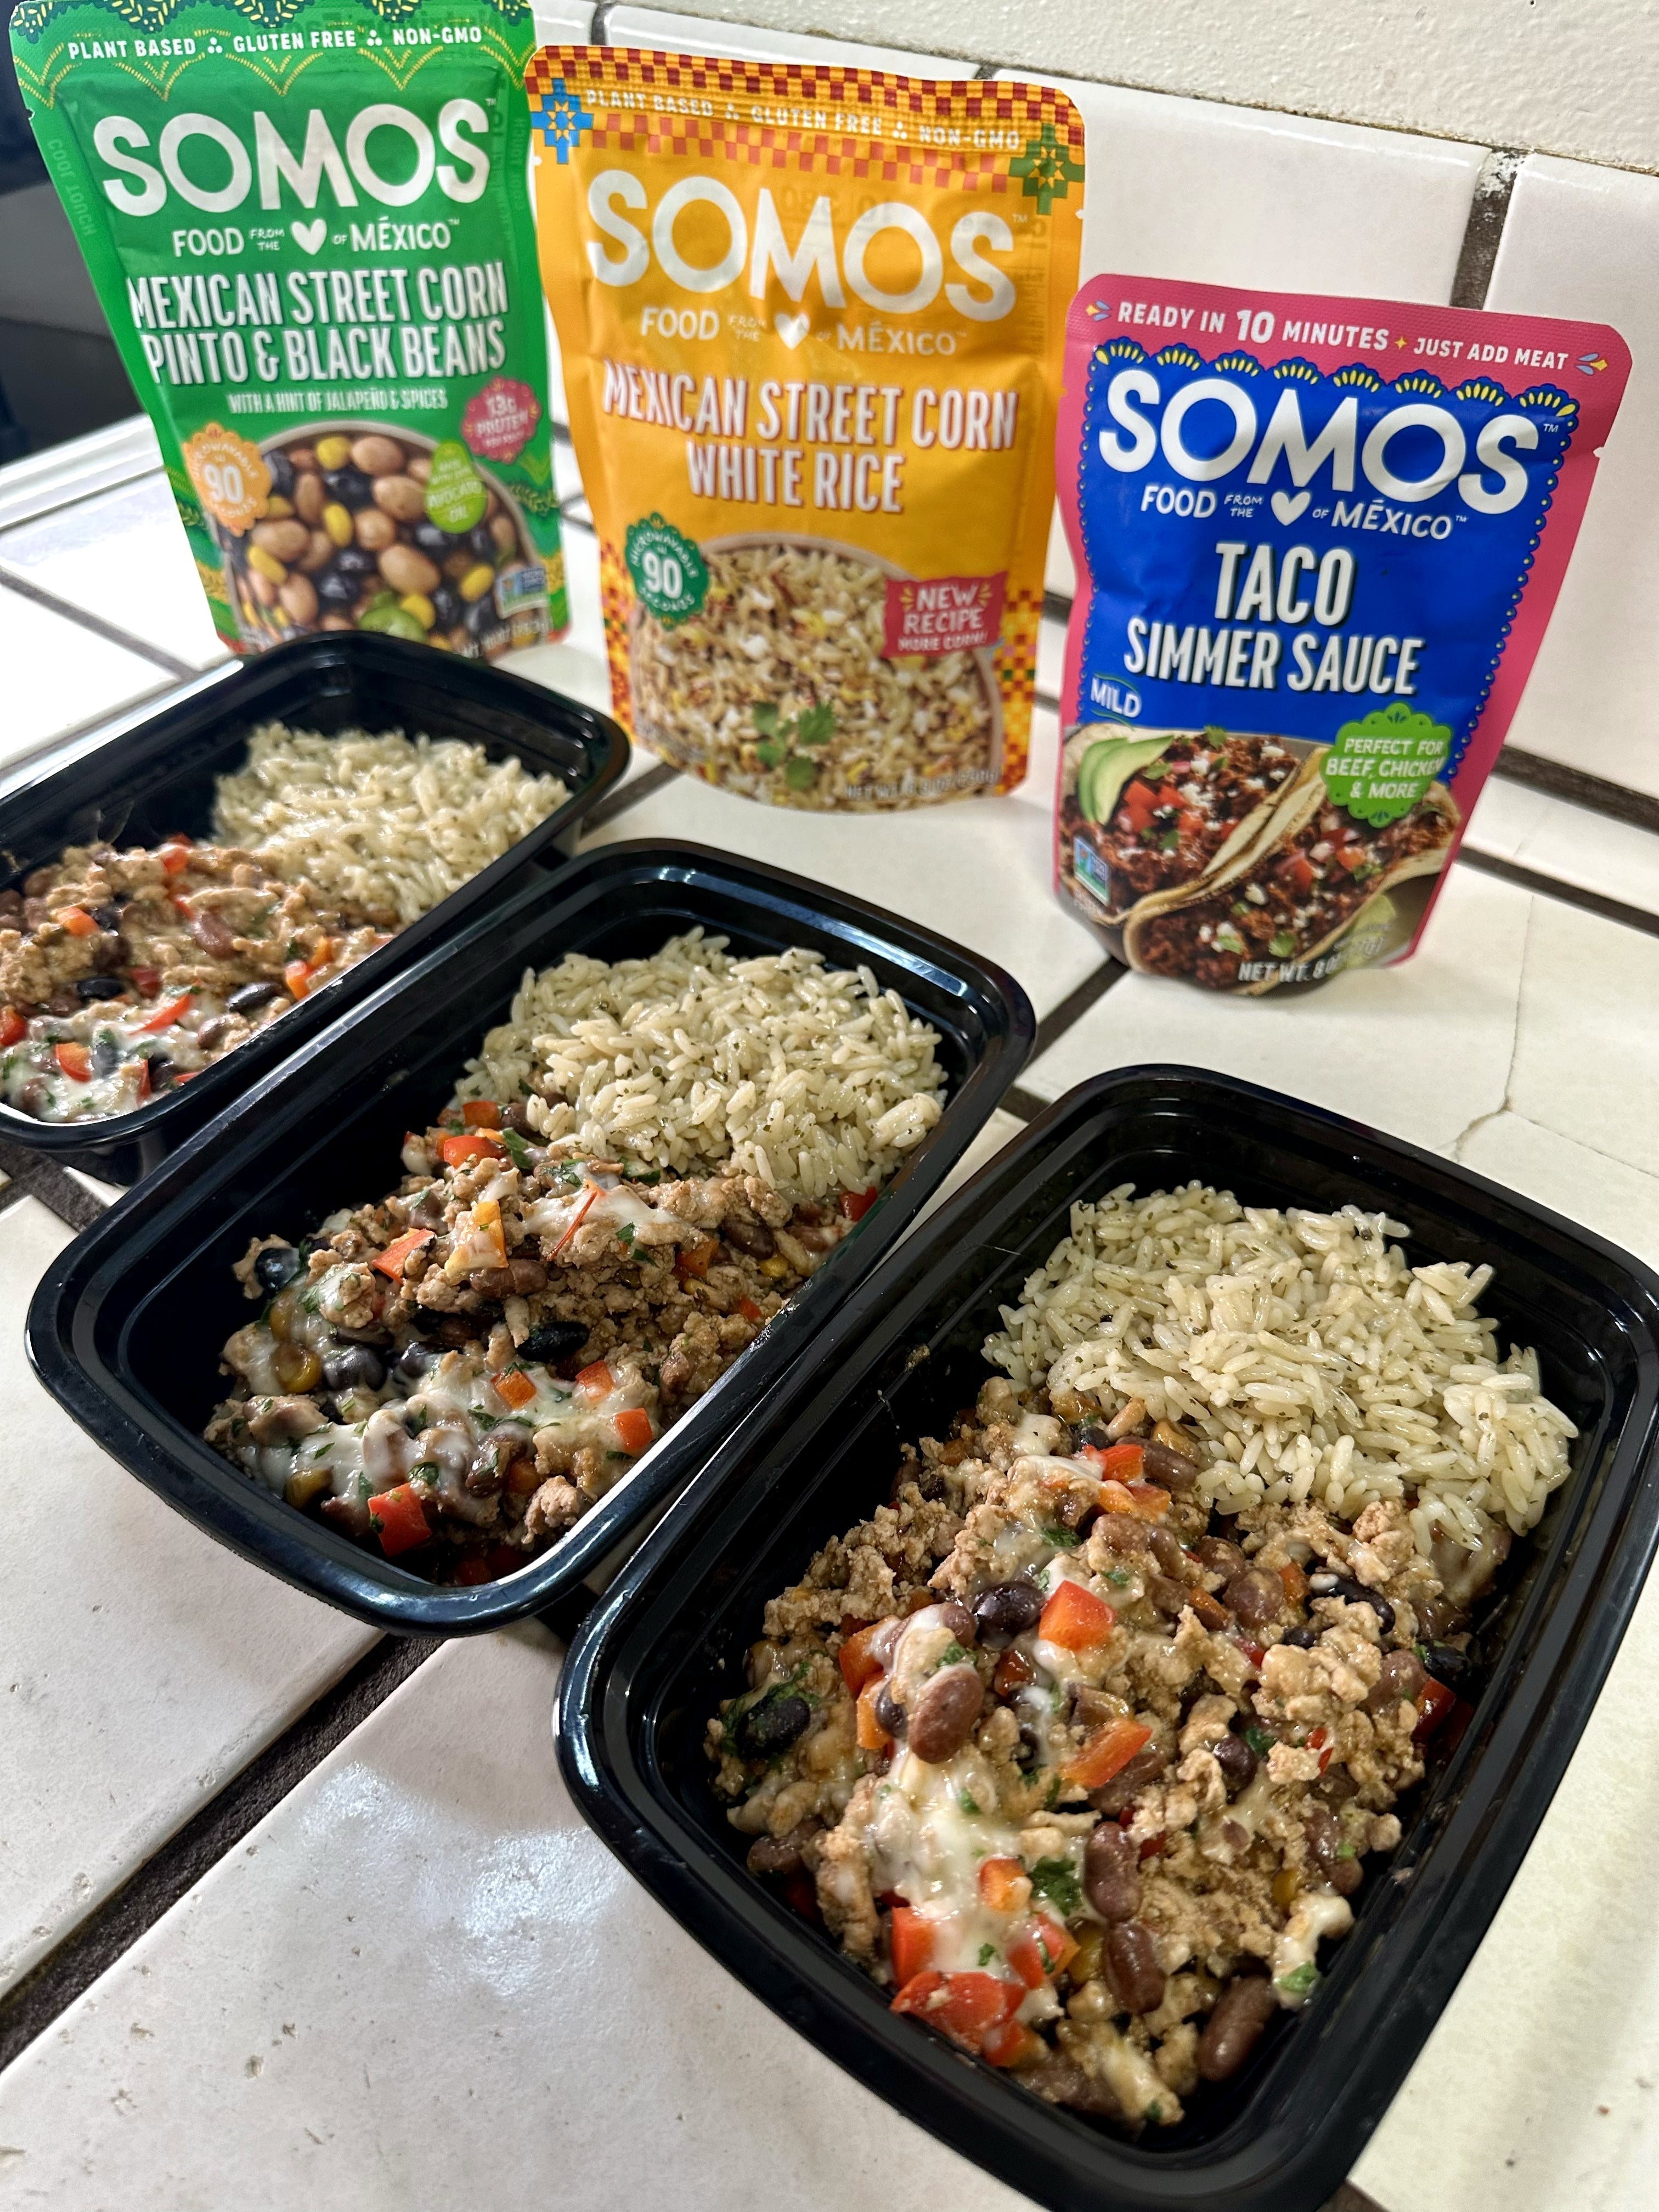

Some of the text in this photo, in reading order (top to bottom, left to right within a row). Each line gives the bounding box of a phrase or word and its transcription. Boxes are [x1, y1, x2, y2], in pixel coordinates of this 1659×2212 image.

[68, 38, 195, 59] PLANT BASED
[234, 30, 356, 53] GLUTEN FREE
[393, 26, 481, 45] NON-GMO
[586, 89, 713, 116] PLANT BASED
[751, 105, 882, 136] GLUTEN FREE
[919, 126, 1020, 149] NON-GMO
[93, 99, 490, 216] SOMOS
[172, 228, 244, 257] FOOD
[249, 229, 285, 239] FROM
[257, 241, 280, 251] THE
[332, 234, 347, 245] OF
[349, 216, 451, 251] MÉXICO
[586, 169, 1016, 321] SOMOS
[126, 261, 508, 329] MEXICAN STREET CORN
[640, 307, 719, 340] FOOD
[727, 314, 766, 328] FROM
[1118, 302, 1390, 351] READY IN 10 MINUTES
[735, 330, 759, 342] THE
[836, 320, 956, 356] MÉXICO
[141, 320, 506, 385] PINTO & BLACK BEANS
[1413, 337, 1569, 370] JUST ADD MEAT
[227, 393, 262, 413] WITH
[264, 393, 274, 413] A
[275, 392, 304, 413] HINT
[307, 392, 321, 411] OF
[400, 386, 448, 409] SPICES
[602, 361, 1019, 450] MEXICAN STREET CORN
[1099, 369, 1538, 515] SOMOS
[203, 464, 244, 504] 90
[686, 440, 907, 514] WHITE RICE
[1141, 485, 1216, 518] FOOD
[1224, 494, 1263, 506] FROM
[1229, 508, 1253, 518] THE
[1312, 509, 1329, 518] OF
[1331, 498, 1452, 540] MÉXICO
[642, 550, 682, 599] 90
[1214, 543, 1356, 626] TACO
[916, 582, 979, 611] NEW
[904, 606, 985, 635] RECIPE
[898, 636, 940, 651] MORE
[1123, 617, 1424, 695] SIMMER SAUCE
[1091, 678, 1142, 718] MILD
[1344, 738, 1446, 755] PERFECT FOR
[1325, 757, 1446, 779] BEEF, CHICKEN
[1350, 781, 1420, 799] & MORE
[1238, 962, 1277, 981] NET
